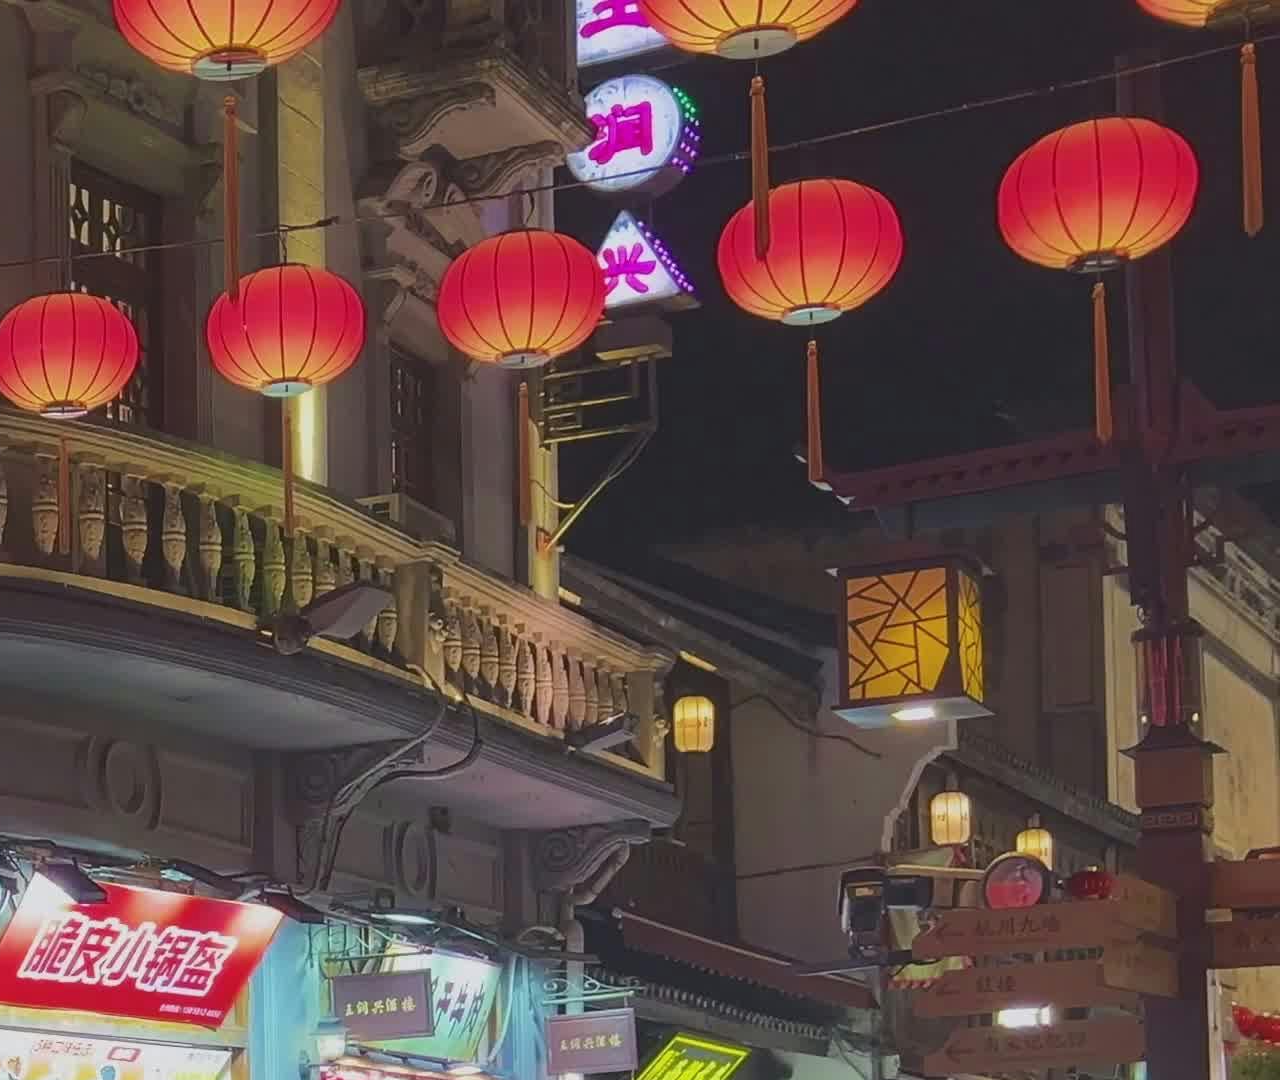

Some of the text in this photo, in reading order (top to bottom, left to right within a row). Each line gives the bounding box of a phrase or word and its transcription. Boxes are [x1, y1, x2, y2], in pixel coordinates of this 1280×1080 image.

[18, 913, 236, 997] 脆皮小锅盔
